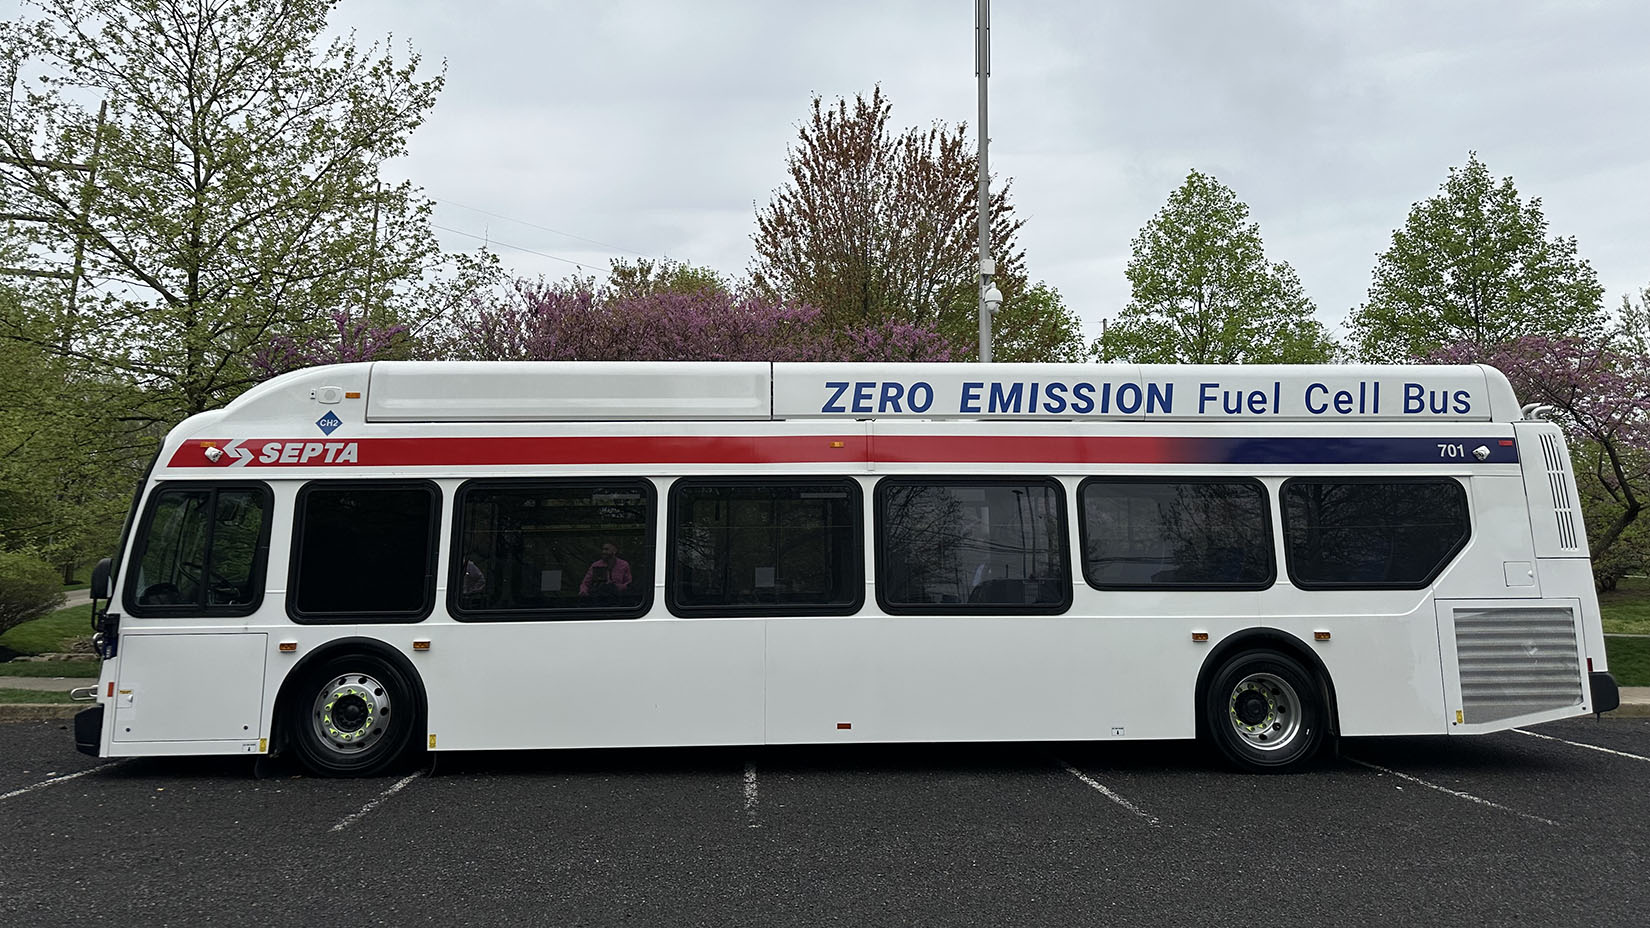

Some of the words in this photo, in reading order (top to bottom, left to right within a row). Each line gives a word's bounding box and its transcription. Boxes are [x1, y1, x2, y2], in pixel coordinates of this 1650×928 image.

[821, 381, 934, 413] ZERO
[959, 382, 1174, 414] EMISSION
[1198, 382, 1281, 414] Fuel
[1304, 382, 1380, 414] Cell
[1403, 383, 1471, 415] Bus
[320, 419, 339, 427] CH2
[258, 442, 358, 463] SEPTA
[1437, 444, 1464, 457] 701
